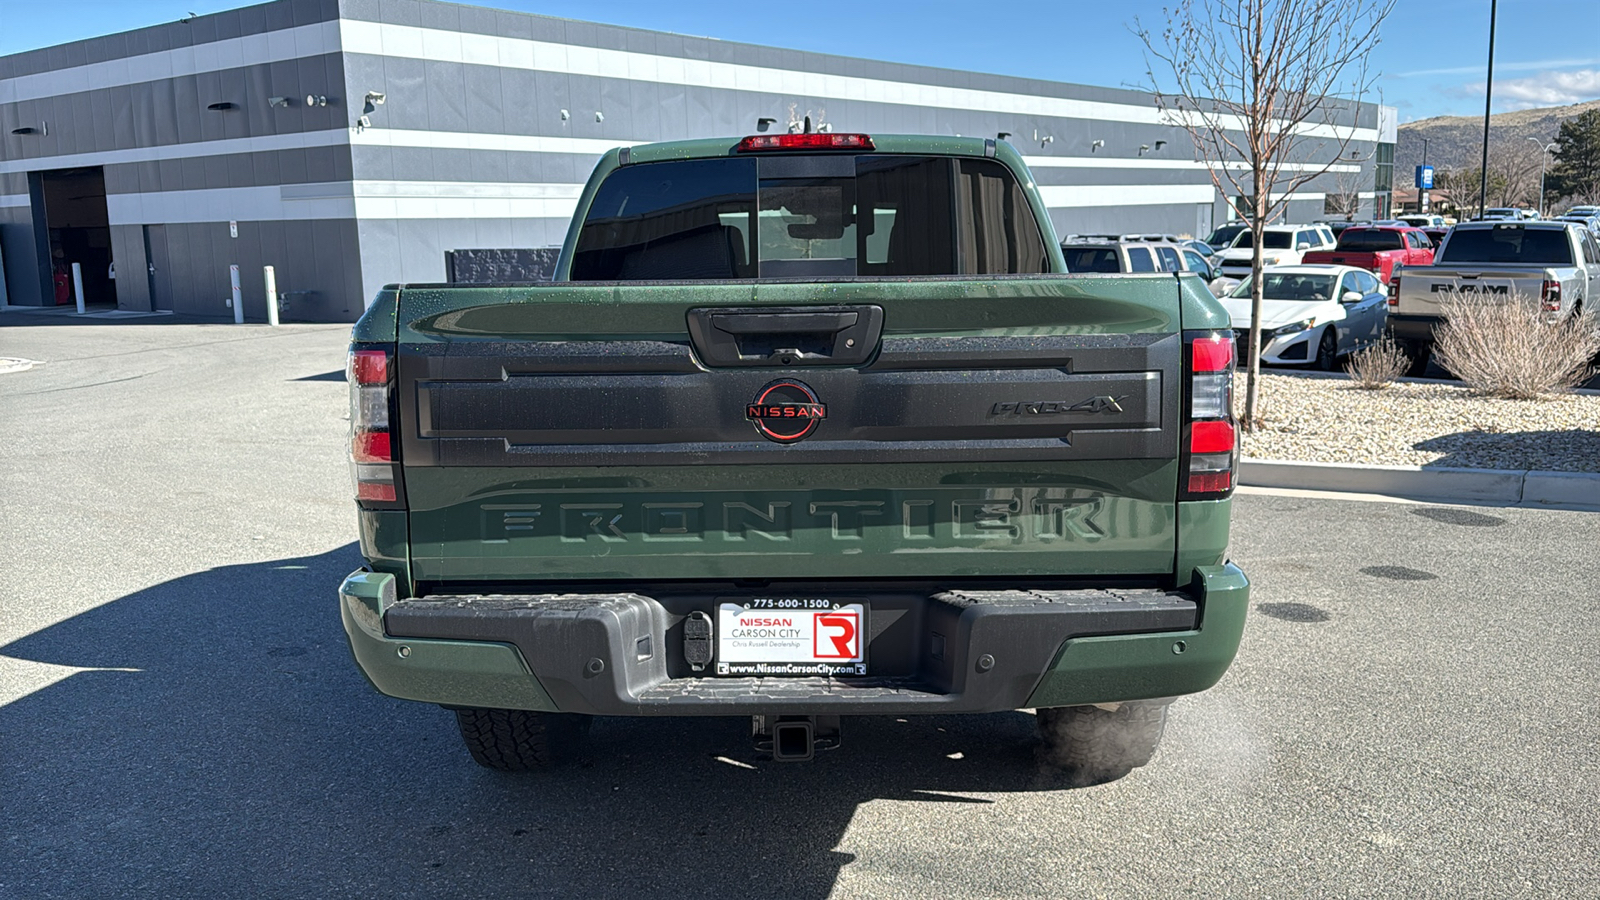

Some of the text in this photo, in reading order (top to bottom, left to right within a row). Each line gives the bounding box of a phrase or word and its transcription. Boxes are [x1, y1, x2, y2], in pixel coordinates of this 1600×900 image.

[1431, 283, 1508, 295] RAM
[749, 407, 824, 417] NISSAN
[480, 500, 1106, 540] FRONTIER
[753, 599, 830, 608] 775-600-1500
[740, 618, 792, 627] NISSAN
[732, 629, 801, 638] CARSON CITY
[732, 640, 801, 649] Chris Russell Dealership
[730, 664, 854, 674] www.NissanCarsonCity.com
